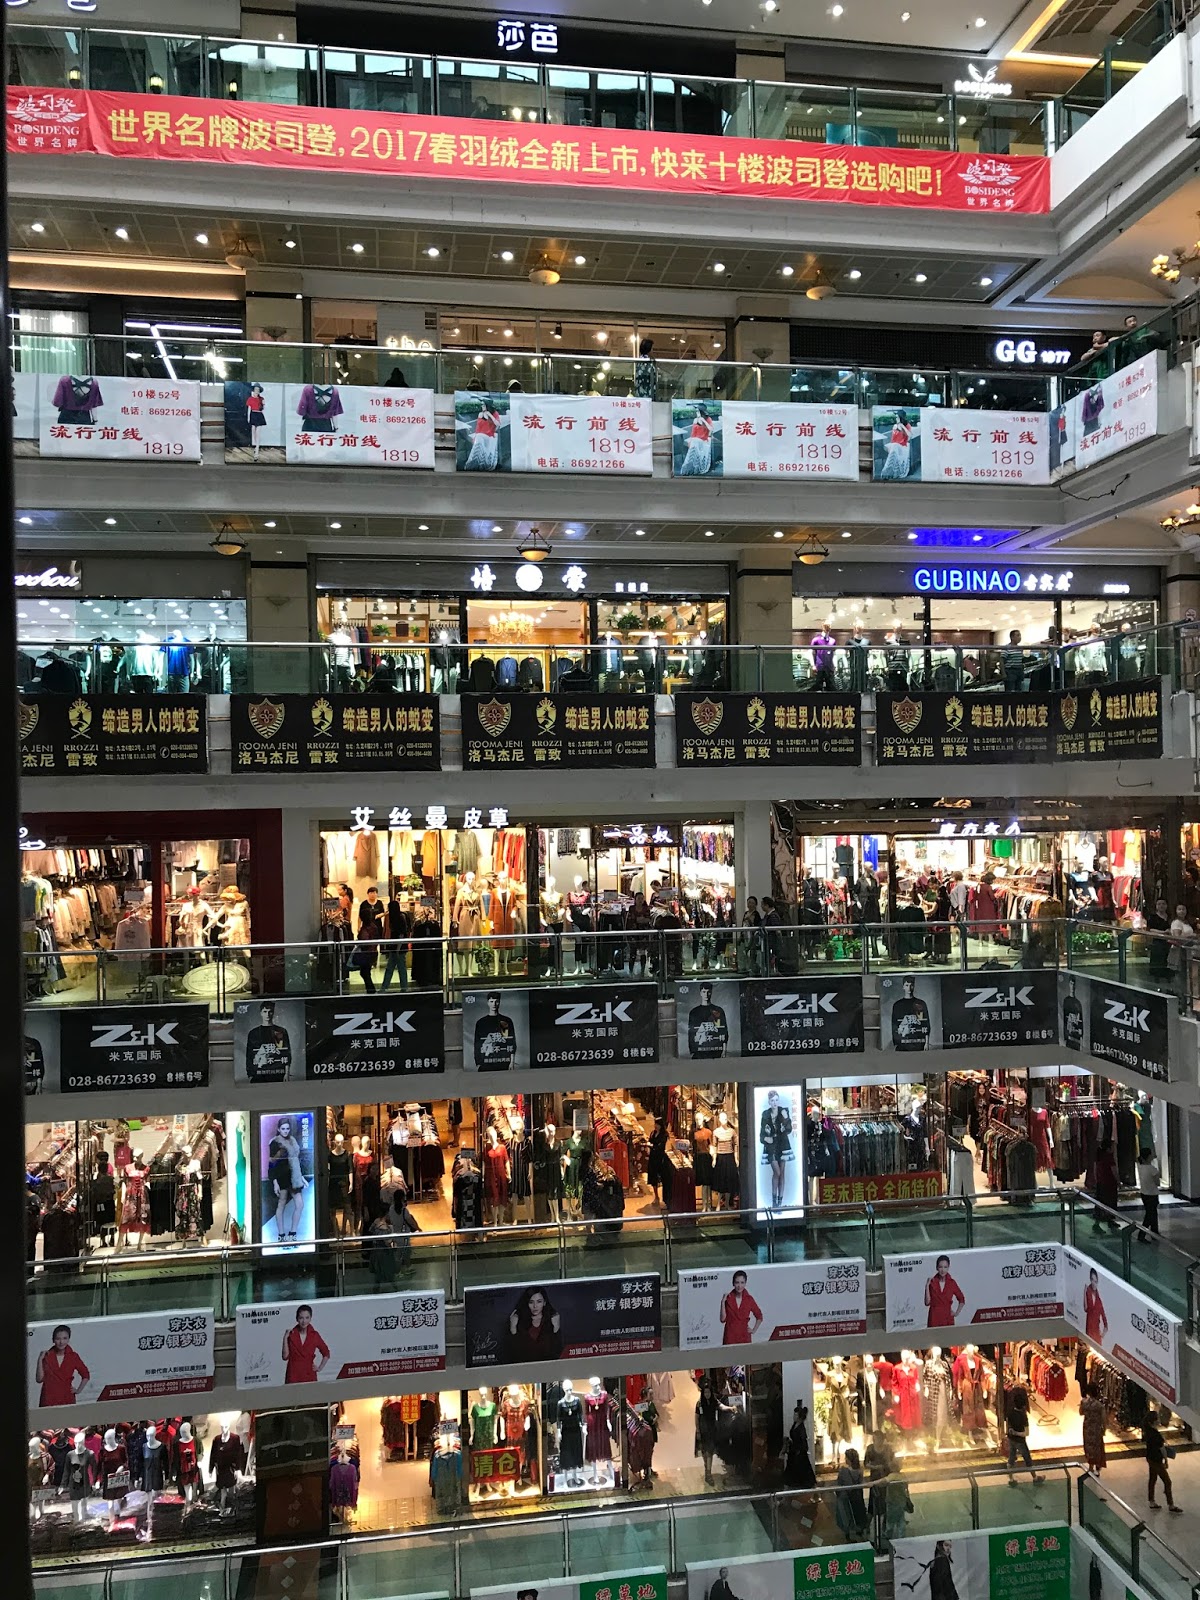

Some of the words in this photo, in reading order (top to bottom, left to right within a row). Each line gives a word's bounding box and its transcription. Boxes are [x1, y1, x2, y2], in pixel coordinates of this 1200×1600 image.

[497, 19, 558, 53] 莎芭
[16, 94, 76, 114] 波司登
[14, 124, 80, 135] BOSIDENG
[17, 137, 78, 148] 世界名牌
[967, 159, 1013, 176] 波司登
[964, 185, 1015, 196] BOSIDENG
[996, 340, 1038, 363] GG
[132, 389, 180, 400] 10楼52号
[369, 398, 415, 408] 10楼52号
[121, 407, 192, 417] 电话：86921266
[359, 414, 426, 424] 电话：86921266
[522, 415, 640, 432] 流行前线
[735, 421, 847, 437] 流行前线
[50, 425, 144, 440] 流行前线
[933, 427, 1038, 445] 流行前线
[1079, 420, 1124, 451] 流行前线
[1124, 422, 1146, 442] 1819
[294, 433, 381, 447] 流行前线
[588, 438, 636, 454] 1819
[143, 441, 184, 455] 1819
[381, 448, 420, 462] 1819
[797, 444, 842, 459] 1819
[537, 458, 625, 469] 电话：86921266
[991, 450, 1034, 465] 1819
[747, 462, 830, 472] 电话：86921266
[944, 467, 1023, 478] 电话：86921266
[914, 569, 1021, 592] GUBINAO
[102, 707, 199, 734] 缔造男人的蜕变
[343, 707, 433, 732] 缔造男人的蜕变
[565, 706, 649, 731] 缔造男人的蜕变
[774, 705, 855, 729] 缔造男人的蜕变
[971, 704, 1048, 728] 缔造男人的蜕变
[64, 744, 99, 752] RROZZI
[239, 742, 275, 750] ROOMA
[278, 742, 297, 750] JENI
[307, 742, 339, 750] RROZZI
[469, 740, 503, 748] ROOMA
[505, 740, 523, 748] JENI
[717, 738, 735, 746] JENI
[309, 750, 339, 764] 雷致
[468, 749, 525, 762] 洛马杰尼
[534, 748, 561, 761] 雷致
[683, 747, 736, 760] 洛马杰尼
[744, 746, 770, 759] 雷致
[883, 745, 934, 758] 洛马杰尼
[942, 744, 968, 757] 雷致
[66, 753, 98, 767] 雷致
[238, 751, 299, 765] 洛马杰尼
[350, 806, 509, 831] 艾丝曼皮草
[780, 1018, 825, 1028] 米克国际
[980, 1011, 1021, 1021] 米克国际
[572, 1027, 619, 1038] 米克国际
[950, 1031, 1018, 1043] 028-86723639
[1025, 1029, 1054, 1039] 8楼6号
[351, 1038, 400, 1049] 米克国际
[747, 1039, 821, 1051] 028-86723639
[829, 1038, 859, 1047] 8楼6号
[109, 1050, 162, 1062] 米克国际
[537, 1049, 614, 1062] 028-86723639
[623, 1047, 654, 1057] 8楼6号
[313, 1060, 395, 1074] 028-86723639
[405, 1058, 439, 1069] 8楼6号
[68, 1073, 156, 1086] 028-86723639
[166, 1071, 202, 1082] 8楼6号
[823, 1181, 878, 1204] 季末清仓
[883, 1177, 940, 1200] 全场特价
[1025, 1249, 1056, 1263] 穿大衣
[827, 1264, 858, 1279] 穿大衣
[1002, 1265, 1023, 1279] 就穿
[1024, 1263, 1056, 1278] 银梦骄
[621, 1281, 652, 1294] 穿大衣
[802, 1281, 824, 1295] 就穿
[825, 1279, 859, 1294] 银梦骄
[402, 1297, 438, 1313] 穿大衣
[595, 1298, 616, 1311] 就穿
[619, 1296, 654, 1310] 银梦骄
[168, 1316, 207, 1332] 穿大衣
[374, 1316, 398, 1330] 就穿
[399, 1313, 439, 1328] 银梦骄
[139, 1335, 165, 1350] 就穿
[166, 1332, 207, 1349] 银梦骄
[474, 1453, 517, 1477] 清仓
[1005, 1535, 1061, 1558] 绿草地
[805, 1559, 865, 1582] 绿草地
